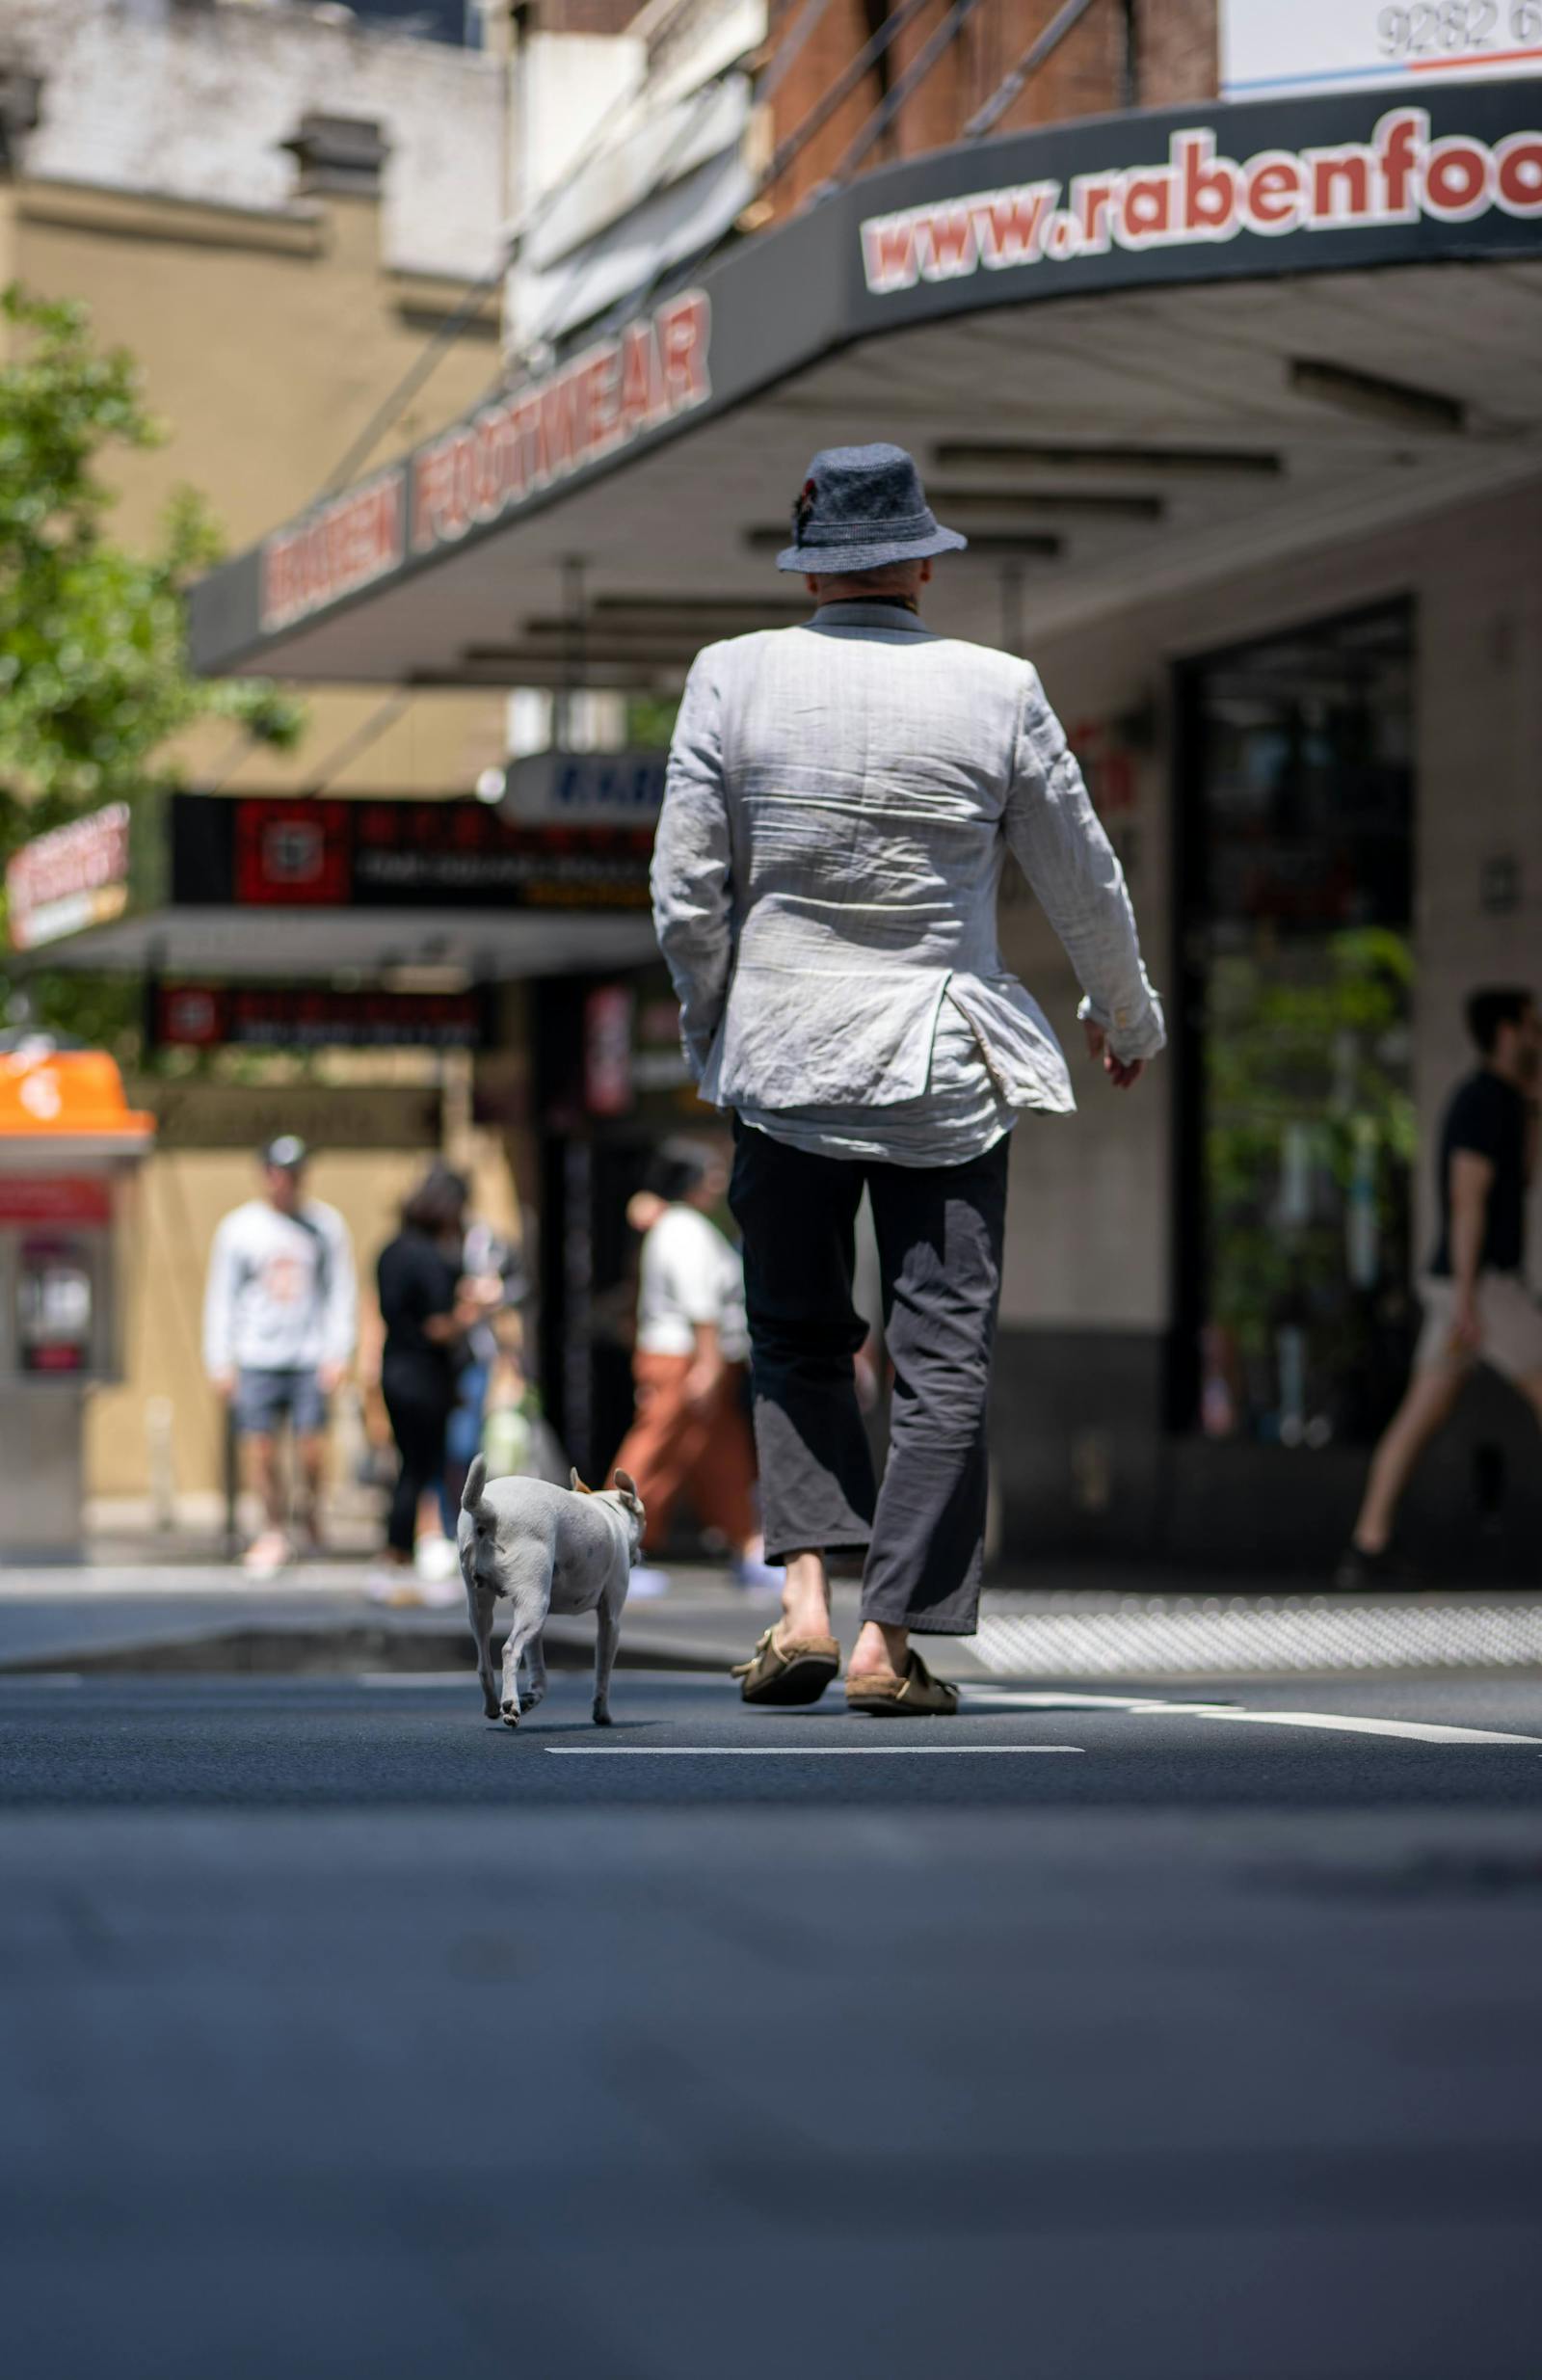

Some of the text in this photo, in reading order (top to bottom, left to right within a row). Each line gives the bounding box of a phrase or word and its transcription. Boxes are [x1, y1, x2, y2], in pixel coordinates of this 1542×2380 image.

[1377, 0, 1498, 59] 9282
[861, 106, 1542, 293] www.rabenfoo
[409, 288, 711, 553] FOOTWEAR
